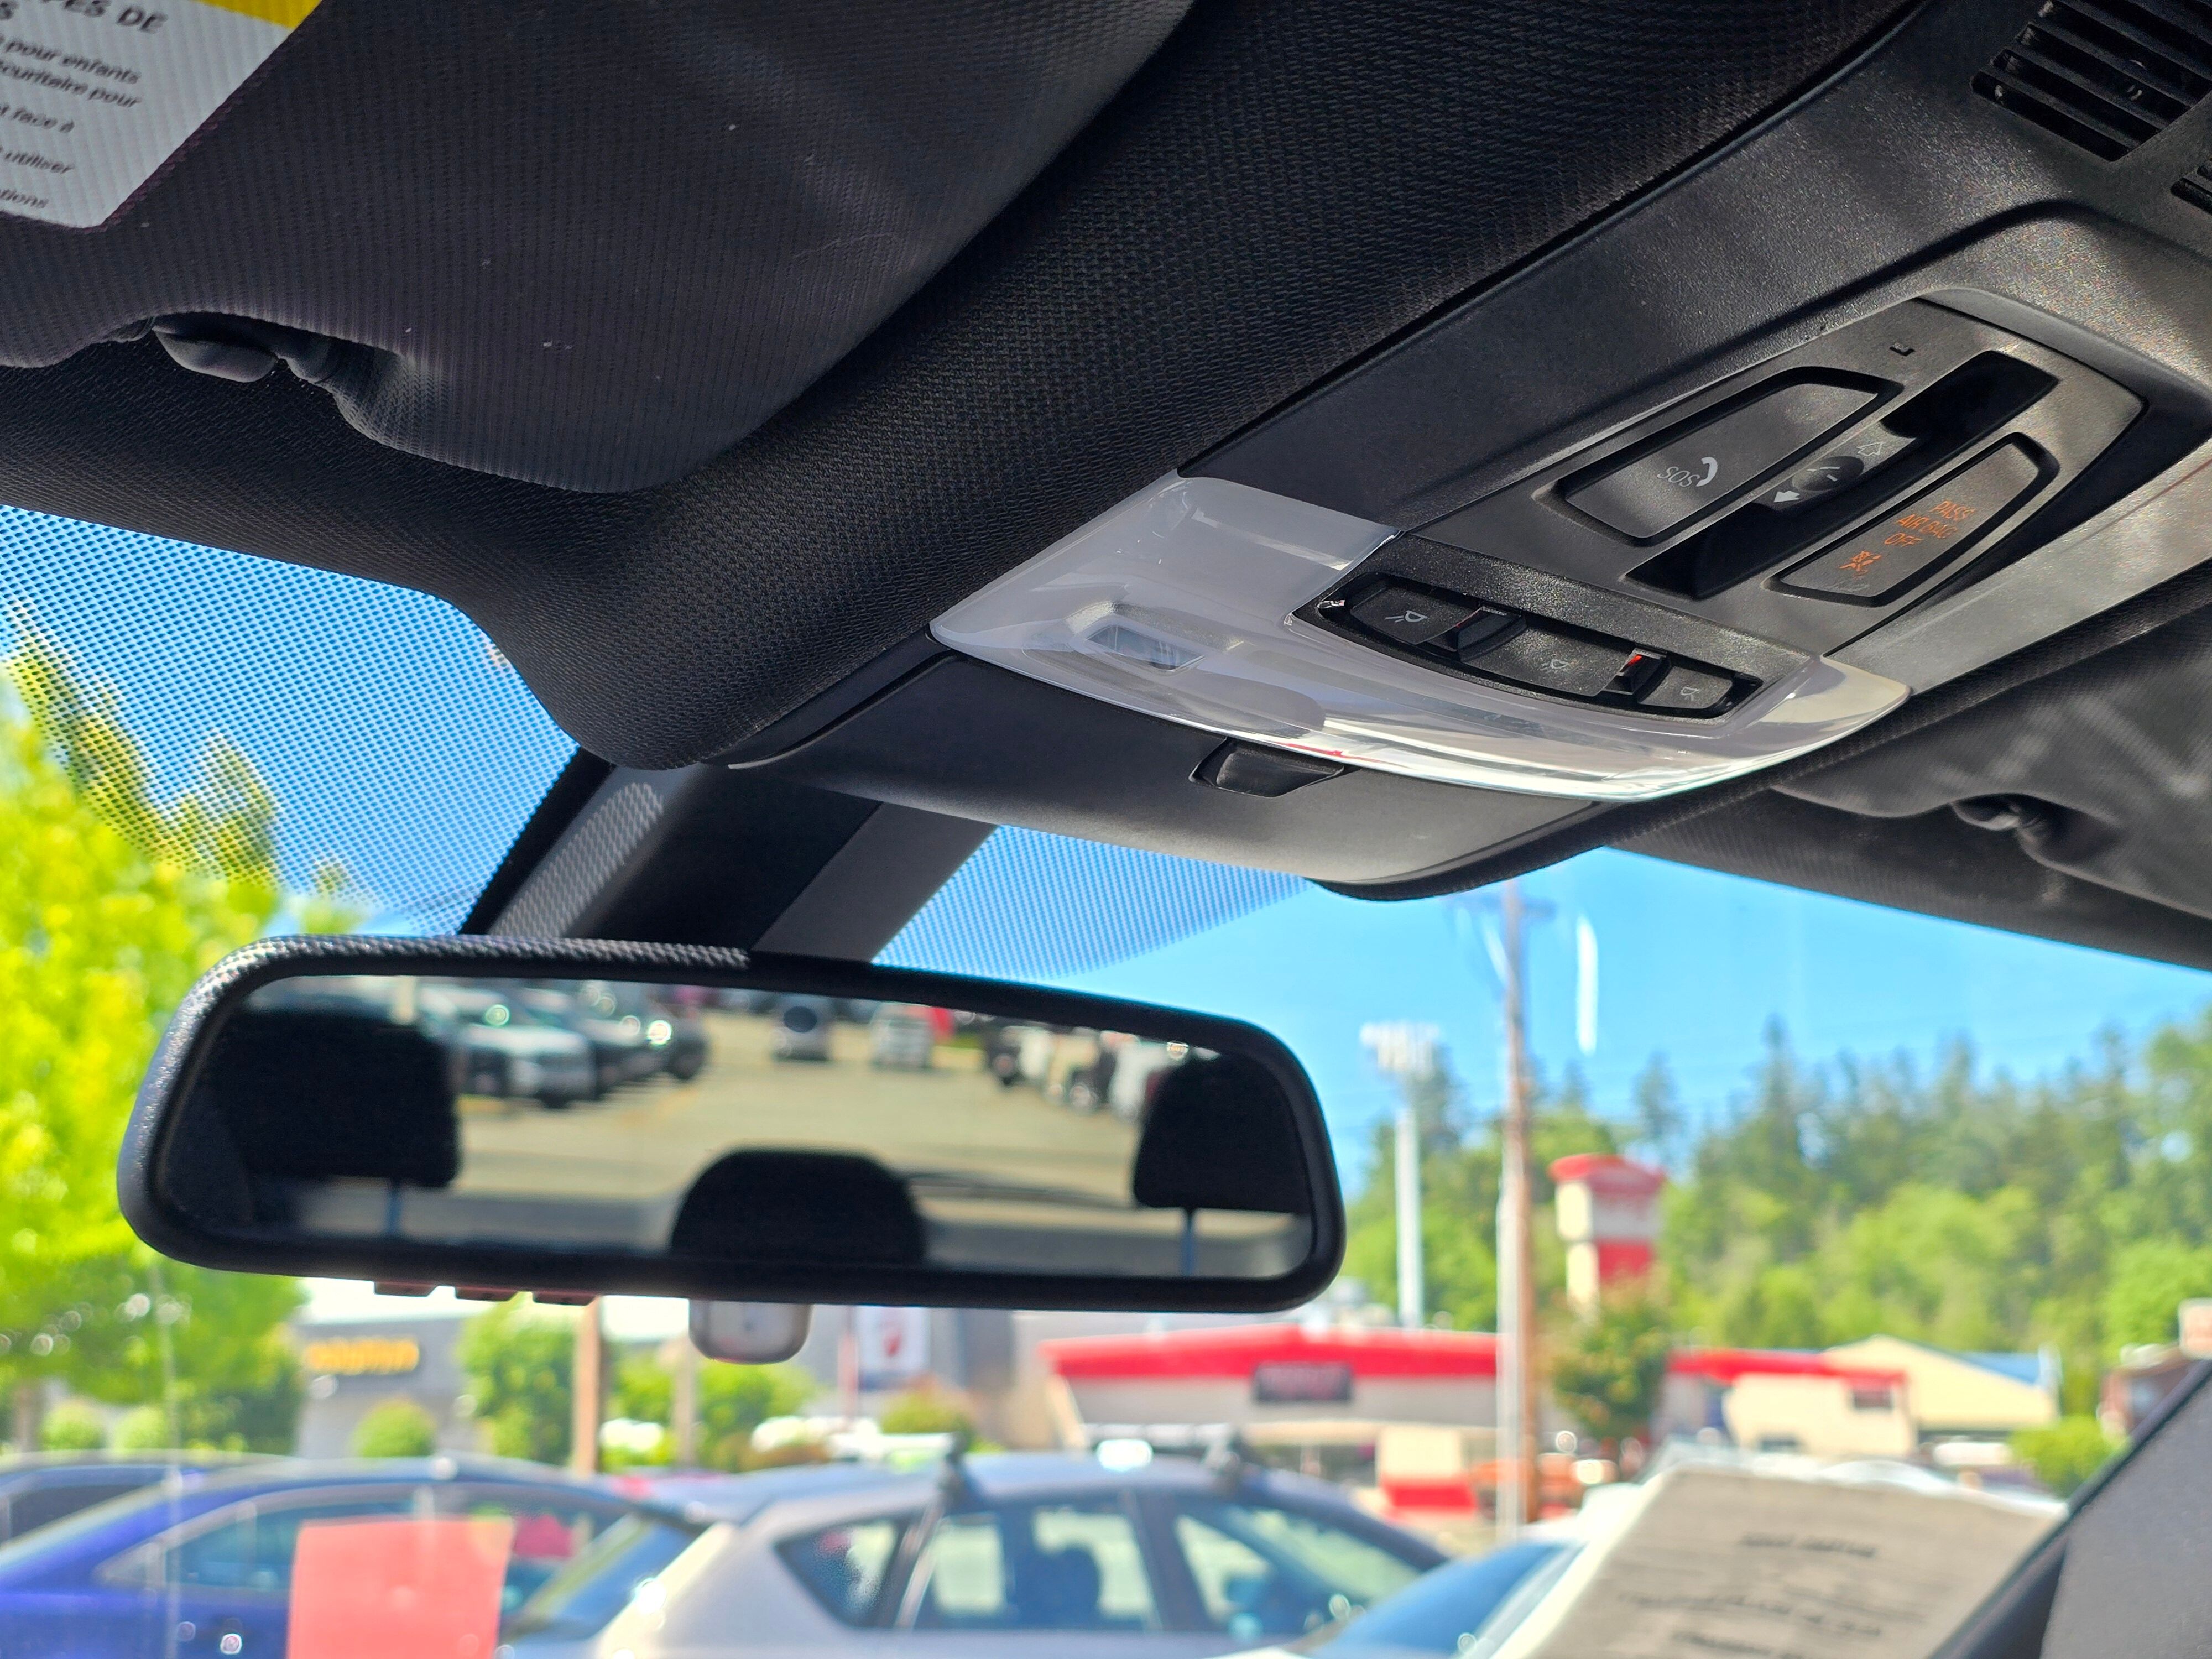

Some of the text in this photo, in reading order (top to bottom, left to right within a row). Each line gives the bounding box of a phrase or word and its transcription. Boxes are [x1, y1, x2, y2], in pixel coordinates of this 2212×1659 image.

[115, 5, 169, 33] DE
[4, 39, 142, 84] pour enfants
[87, 88, 142, 107] pour
[12, 107, 58, 129] face
[1657, 466, 1700, 487] SOS
[1929, 499, 1976, 521] PASS
[1897, 514, 1929, 530] AIR
[1884, 533, 1924, 547] OFF
